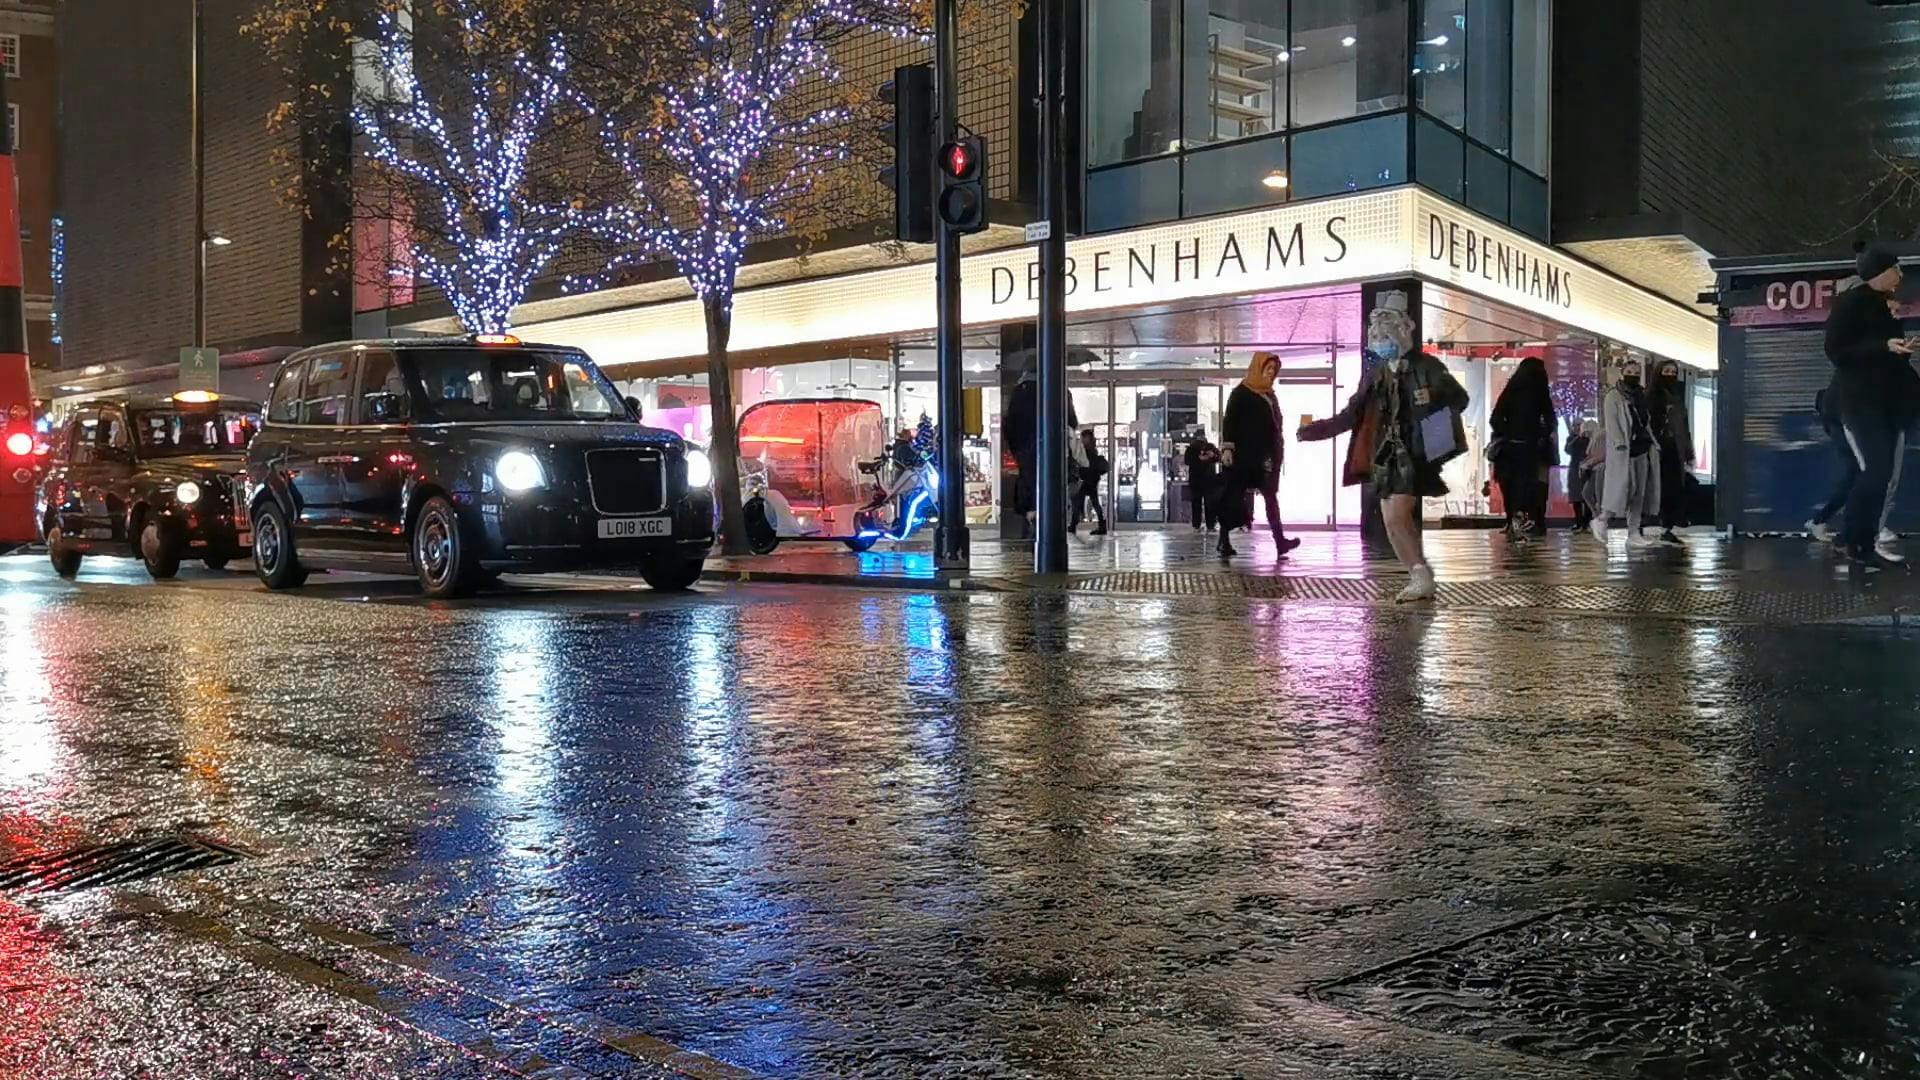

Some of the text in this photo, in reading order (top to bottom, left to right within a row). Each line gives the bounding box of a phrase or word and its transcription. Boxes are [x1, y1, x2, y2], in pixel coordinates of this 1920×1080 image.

[991, 216, 1347, 305] DEBENHAMS
[1429, 213, 1572, 309] DEBENHAMS
[1766, 280, 1833, 311] COF
[607, 520, 664, 535] LO18 XGC
